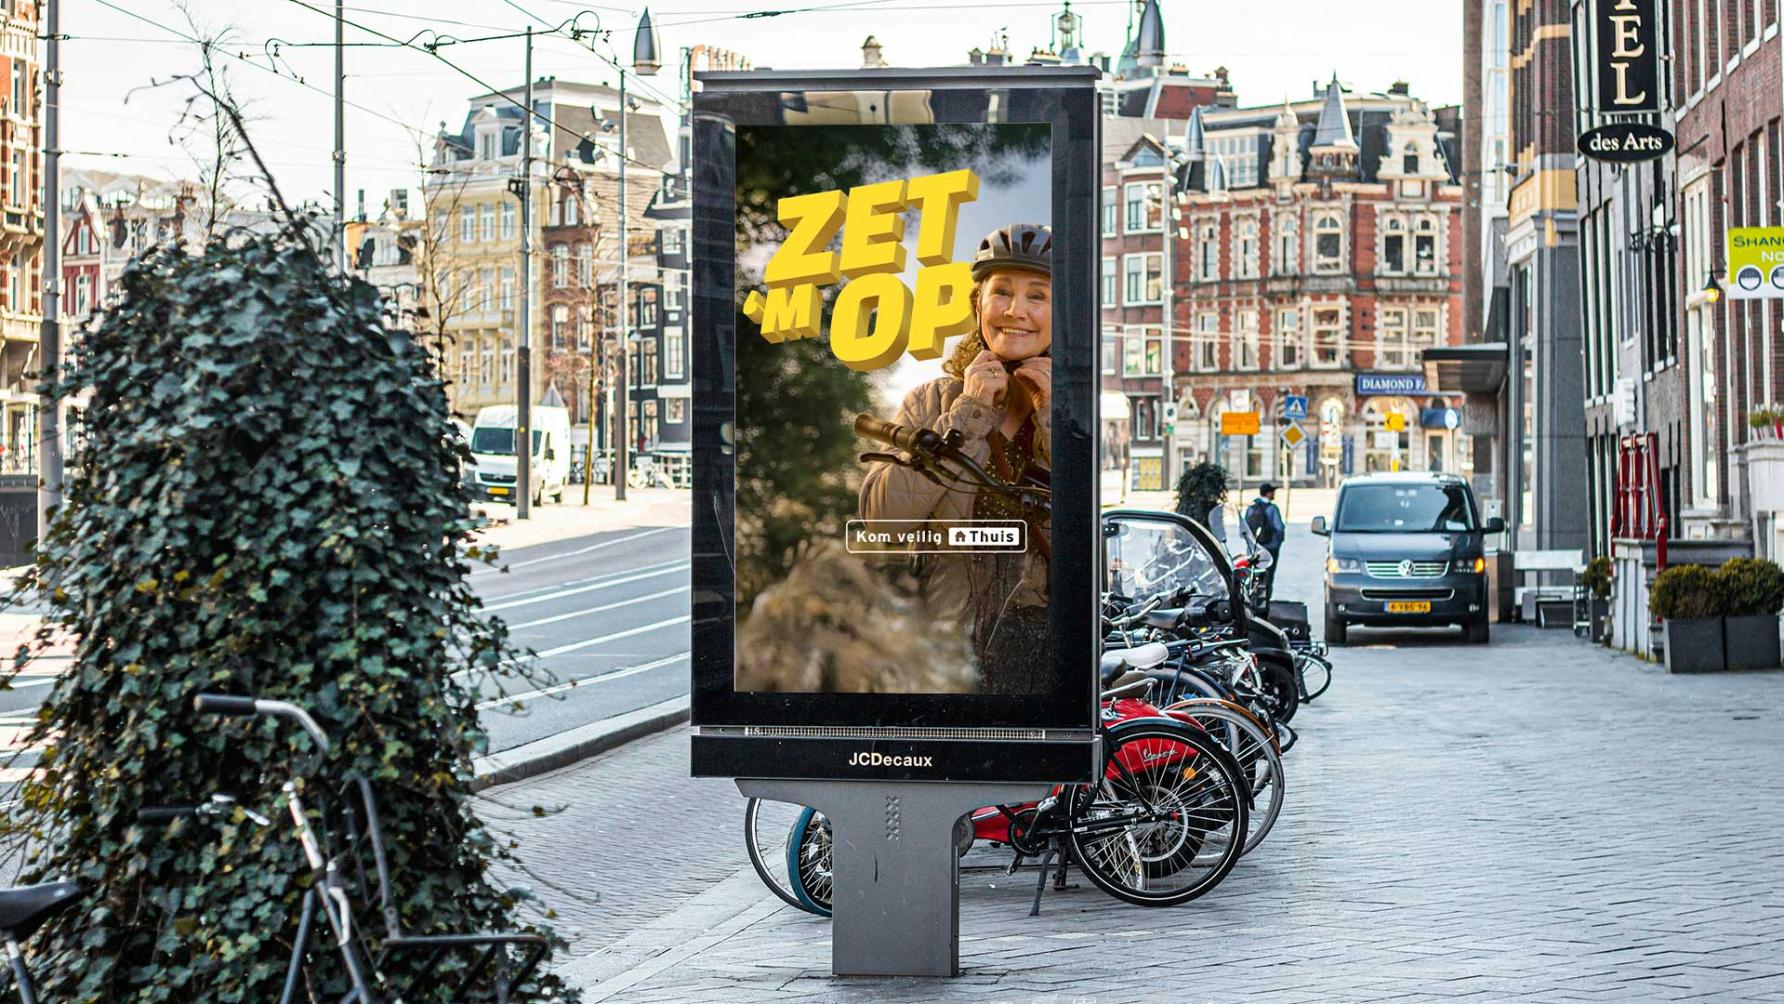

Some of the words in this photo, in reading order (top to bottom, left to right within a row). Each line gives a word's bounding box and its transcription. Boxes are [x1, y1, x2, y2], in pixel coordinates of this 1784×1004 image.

[1608, 0, 1647, 105] EL
[1589, 132, 1619, 151] des
[1623, 132, 1663, 151] Arts
[764, 168, 979, 288] ZET
[1734, 235, 1784, 248] SHAN
[830, 261, 977, 372] OP
[1362, 378, 1413, 390] DIAMOND
[856, 530, 891, 543] Kom
[897, 530, 942, 545] veilig
[970, 530, 1014, 543] Thuis
[849, 752, 933, 767] JCDecaux
